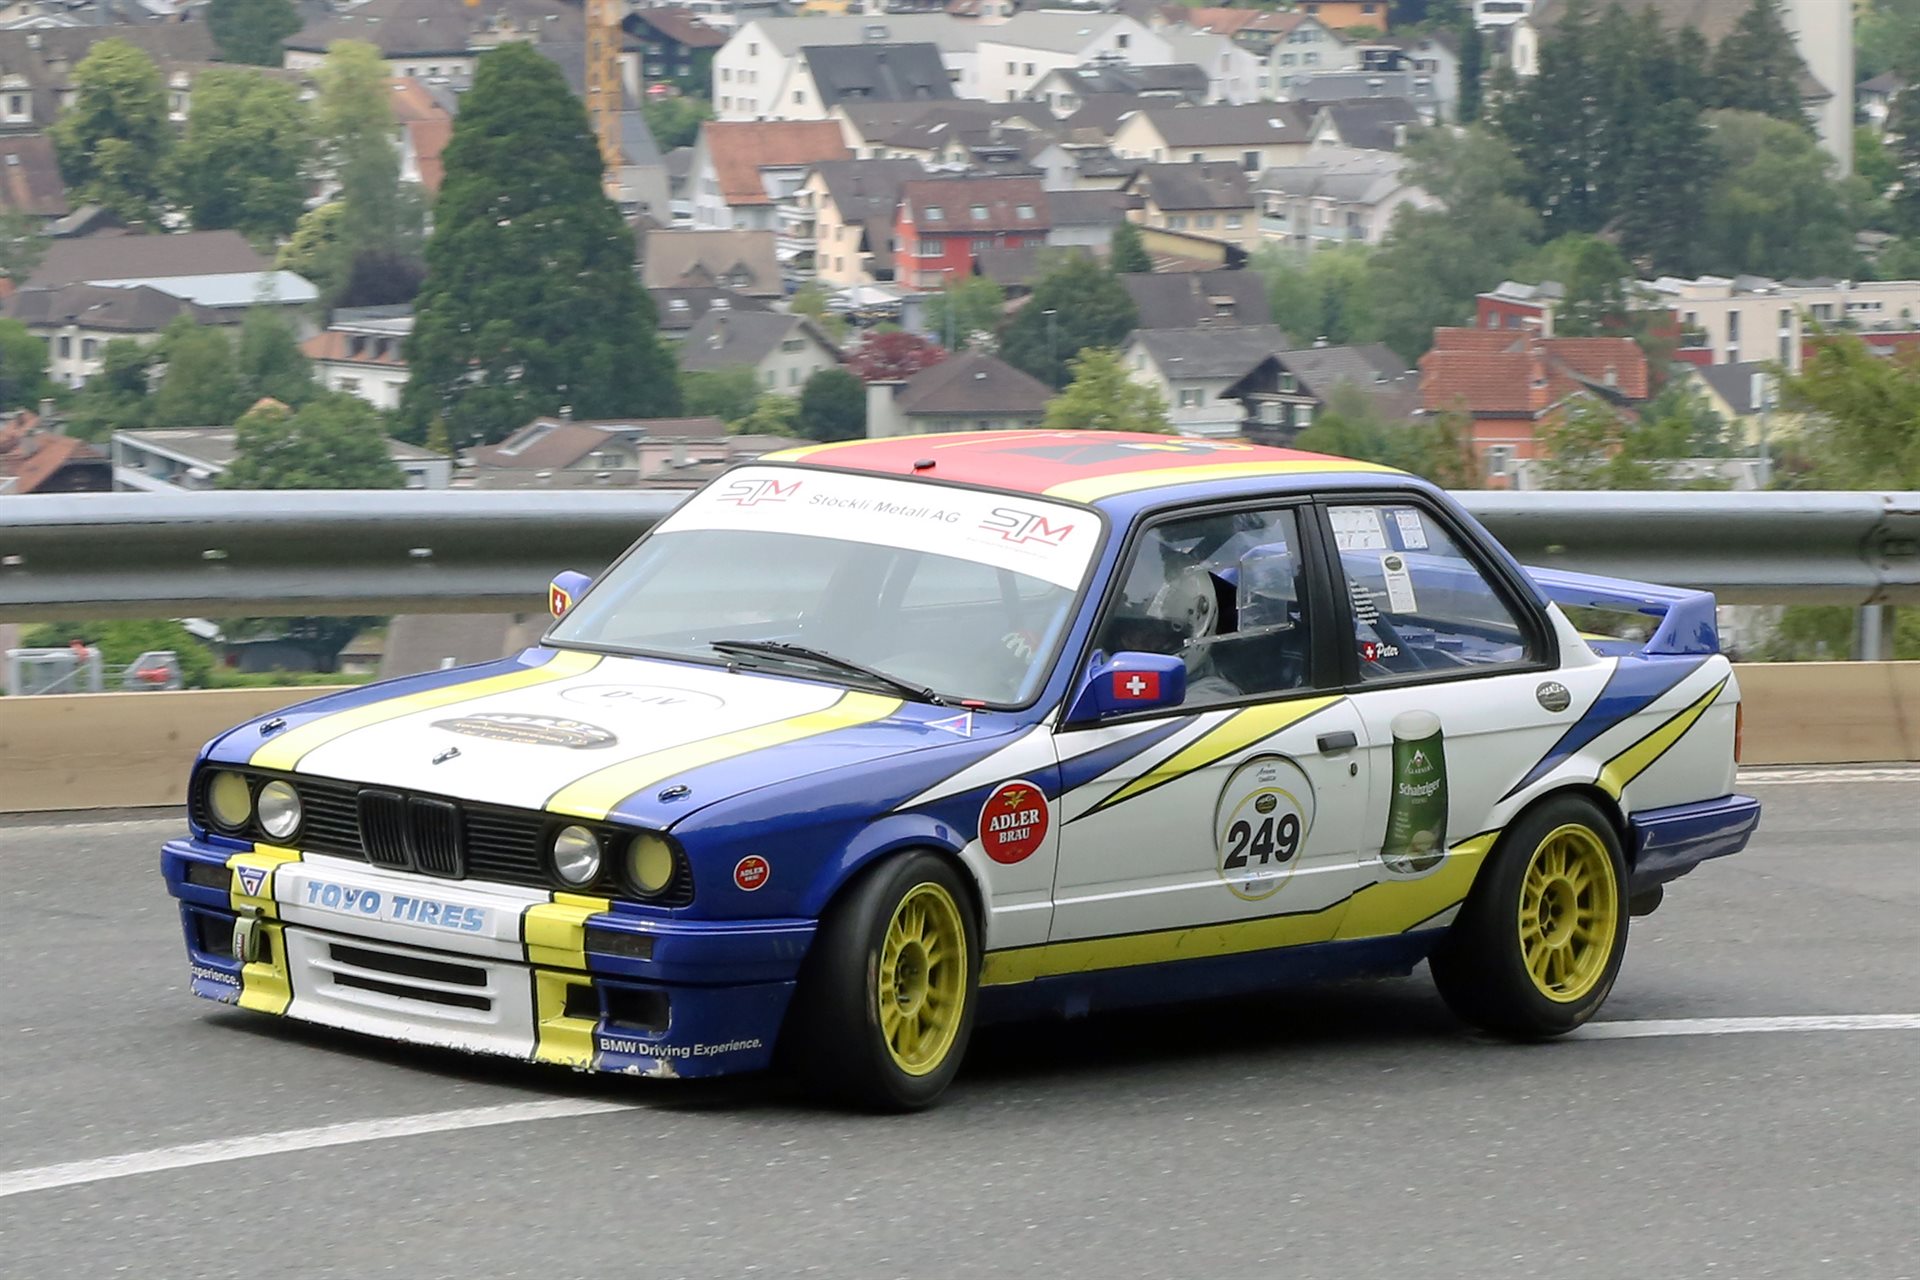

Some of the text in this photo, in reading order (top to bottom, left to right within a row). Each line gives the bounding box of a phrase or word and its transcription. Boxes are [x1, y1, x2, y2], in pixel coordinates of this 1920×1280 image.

[872, 501, 929, 519] Metall
[929, 509, 962, 524] AG
[989, 808, 1040, 832] ADLER
[1223, 813, 1300, 870] 249
[307, 880, 486, 932] TOYO TIRES
[600, 1037, 763, 1059] BMW Driving Experience.
